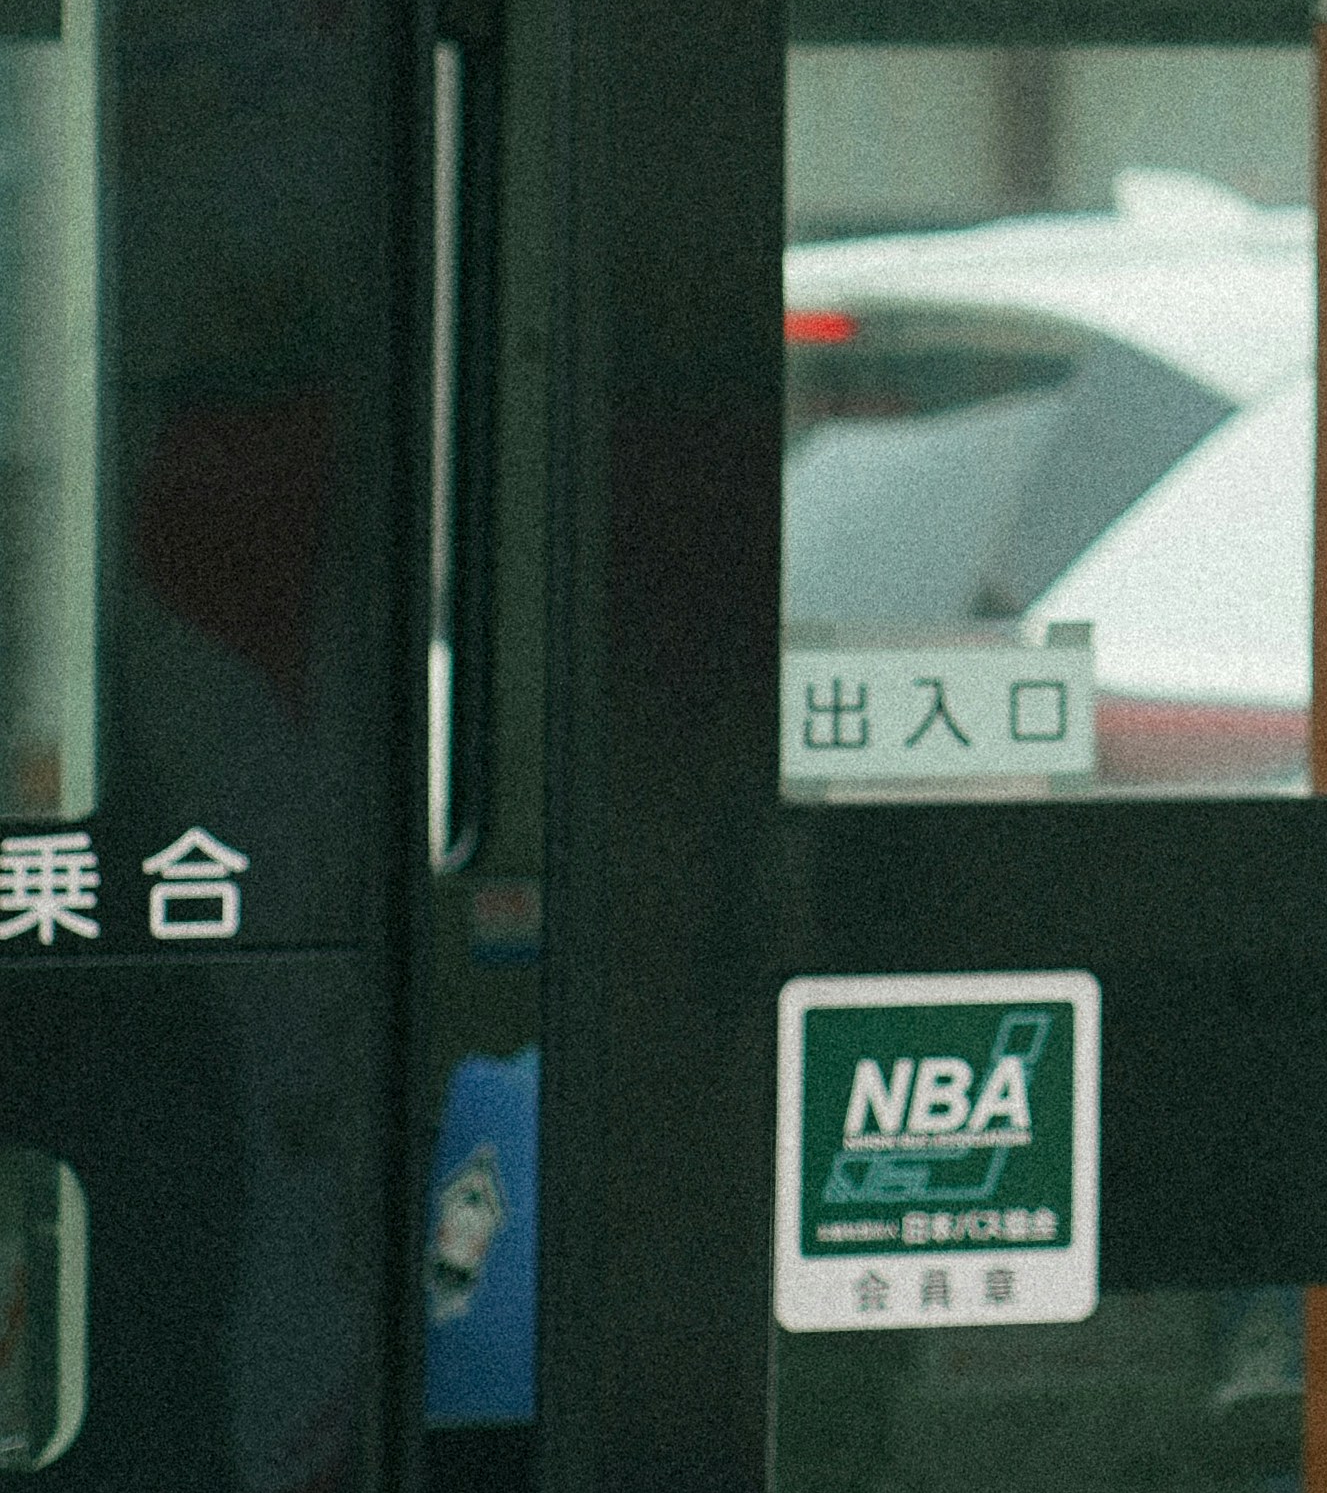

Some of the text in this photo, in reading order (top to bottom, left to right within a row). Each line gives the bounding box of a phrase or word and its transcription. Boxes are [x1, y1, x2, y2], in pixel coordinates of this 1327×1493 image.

[803, 677, 1069, 752] 出入口
[0, 826, 251, 945] 乗合
[842, 1055, 1033, 1134] NBA
[852, 1266, 1017, 1311] 会員章
